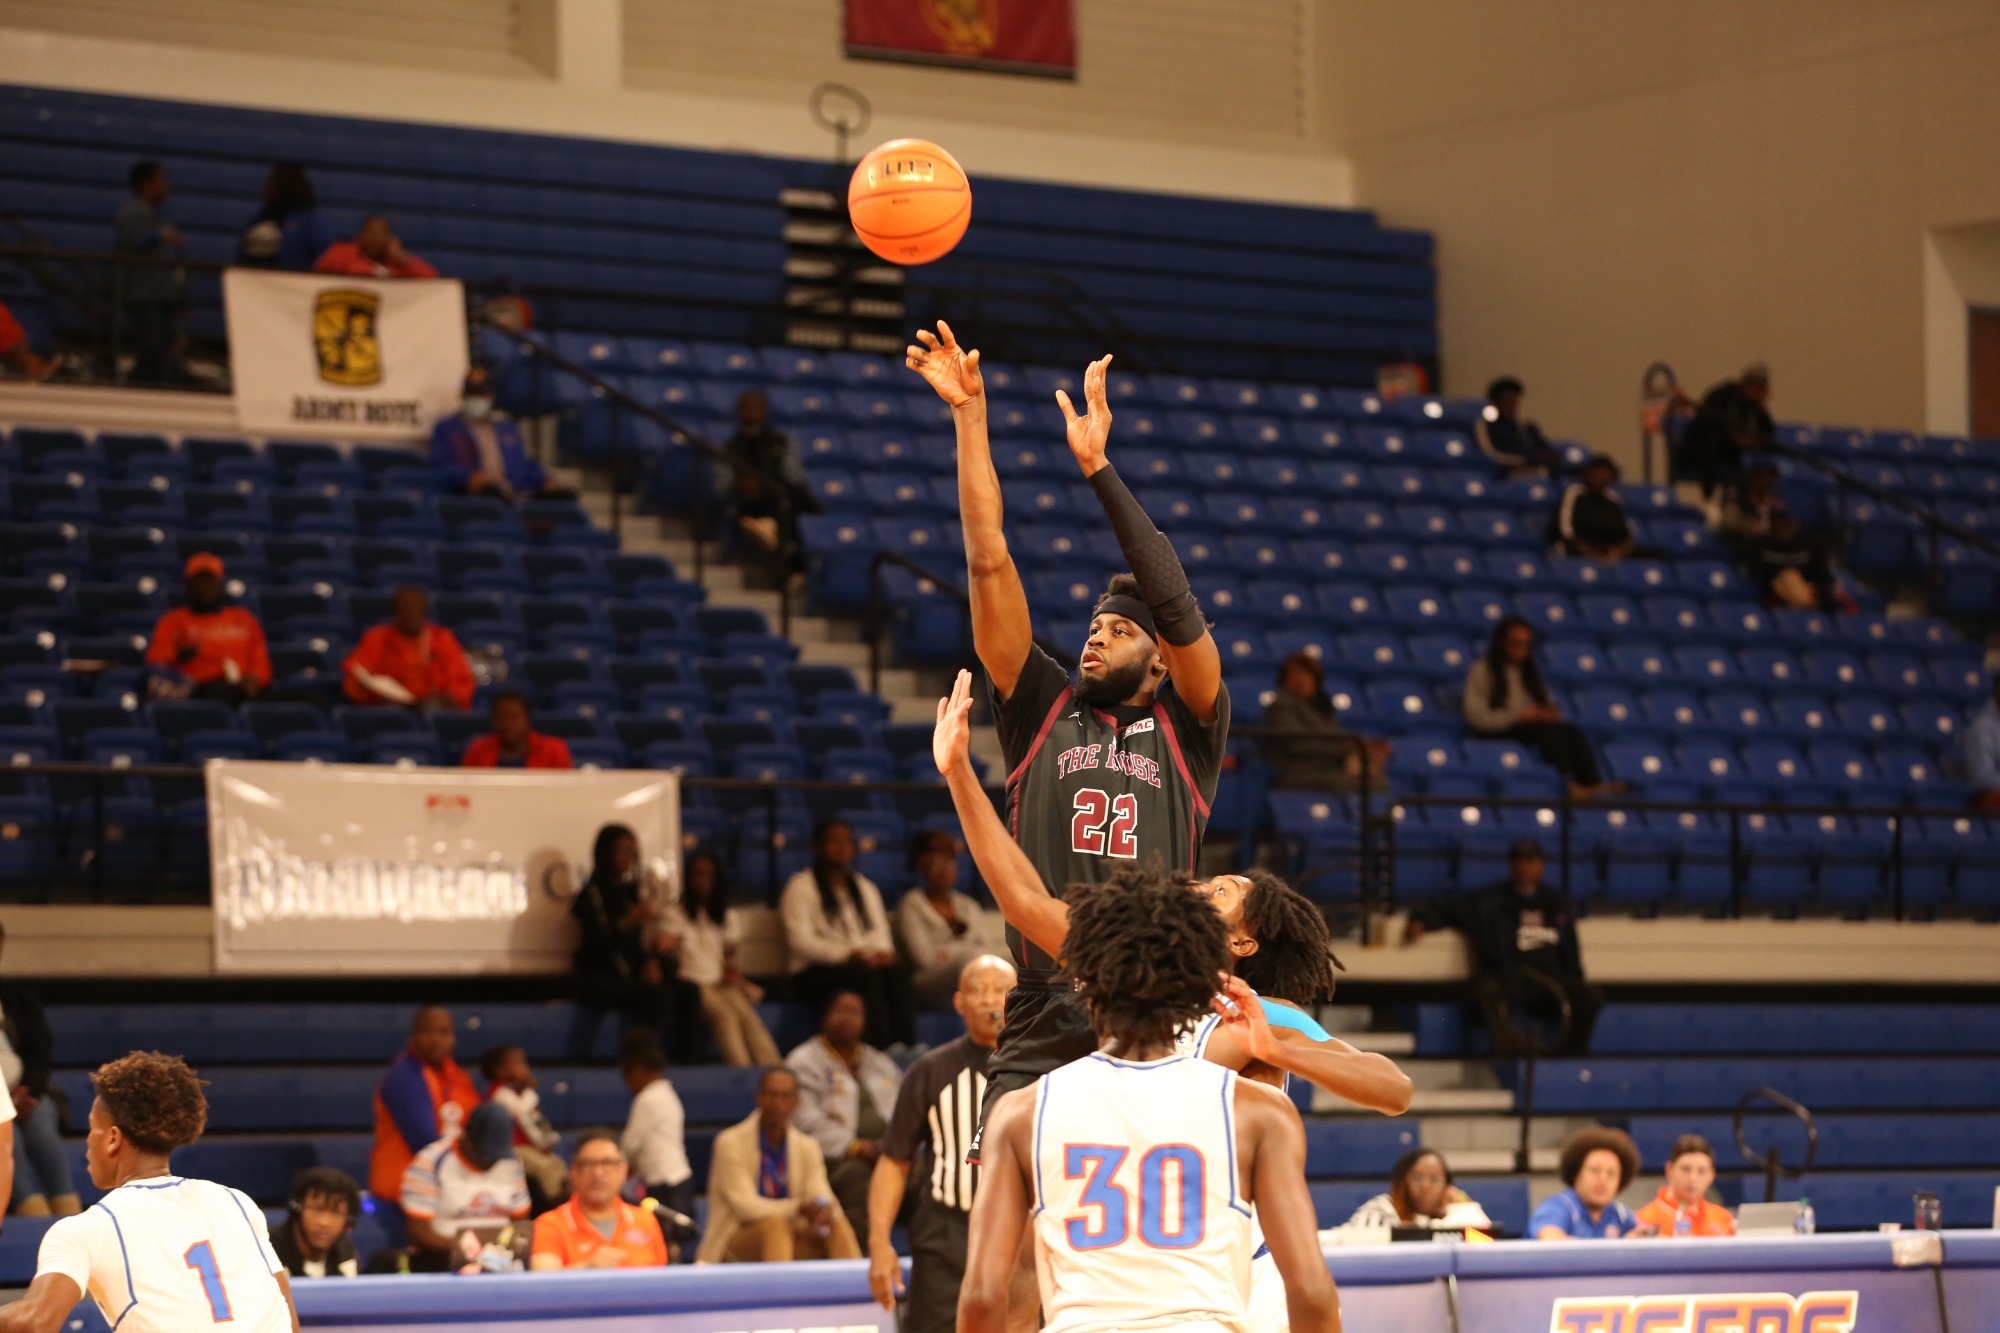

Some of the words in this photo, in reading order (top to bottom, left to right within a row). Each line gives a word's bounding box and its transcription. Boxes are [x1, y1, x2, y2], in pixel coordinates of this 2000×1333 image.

[1057, 743, 1102, 780] THE
[1071, 787, 1138, 860] 22
[1063, 1142, 1206, 1252] 30
[183, 1239, 234, 1323] 1
